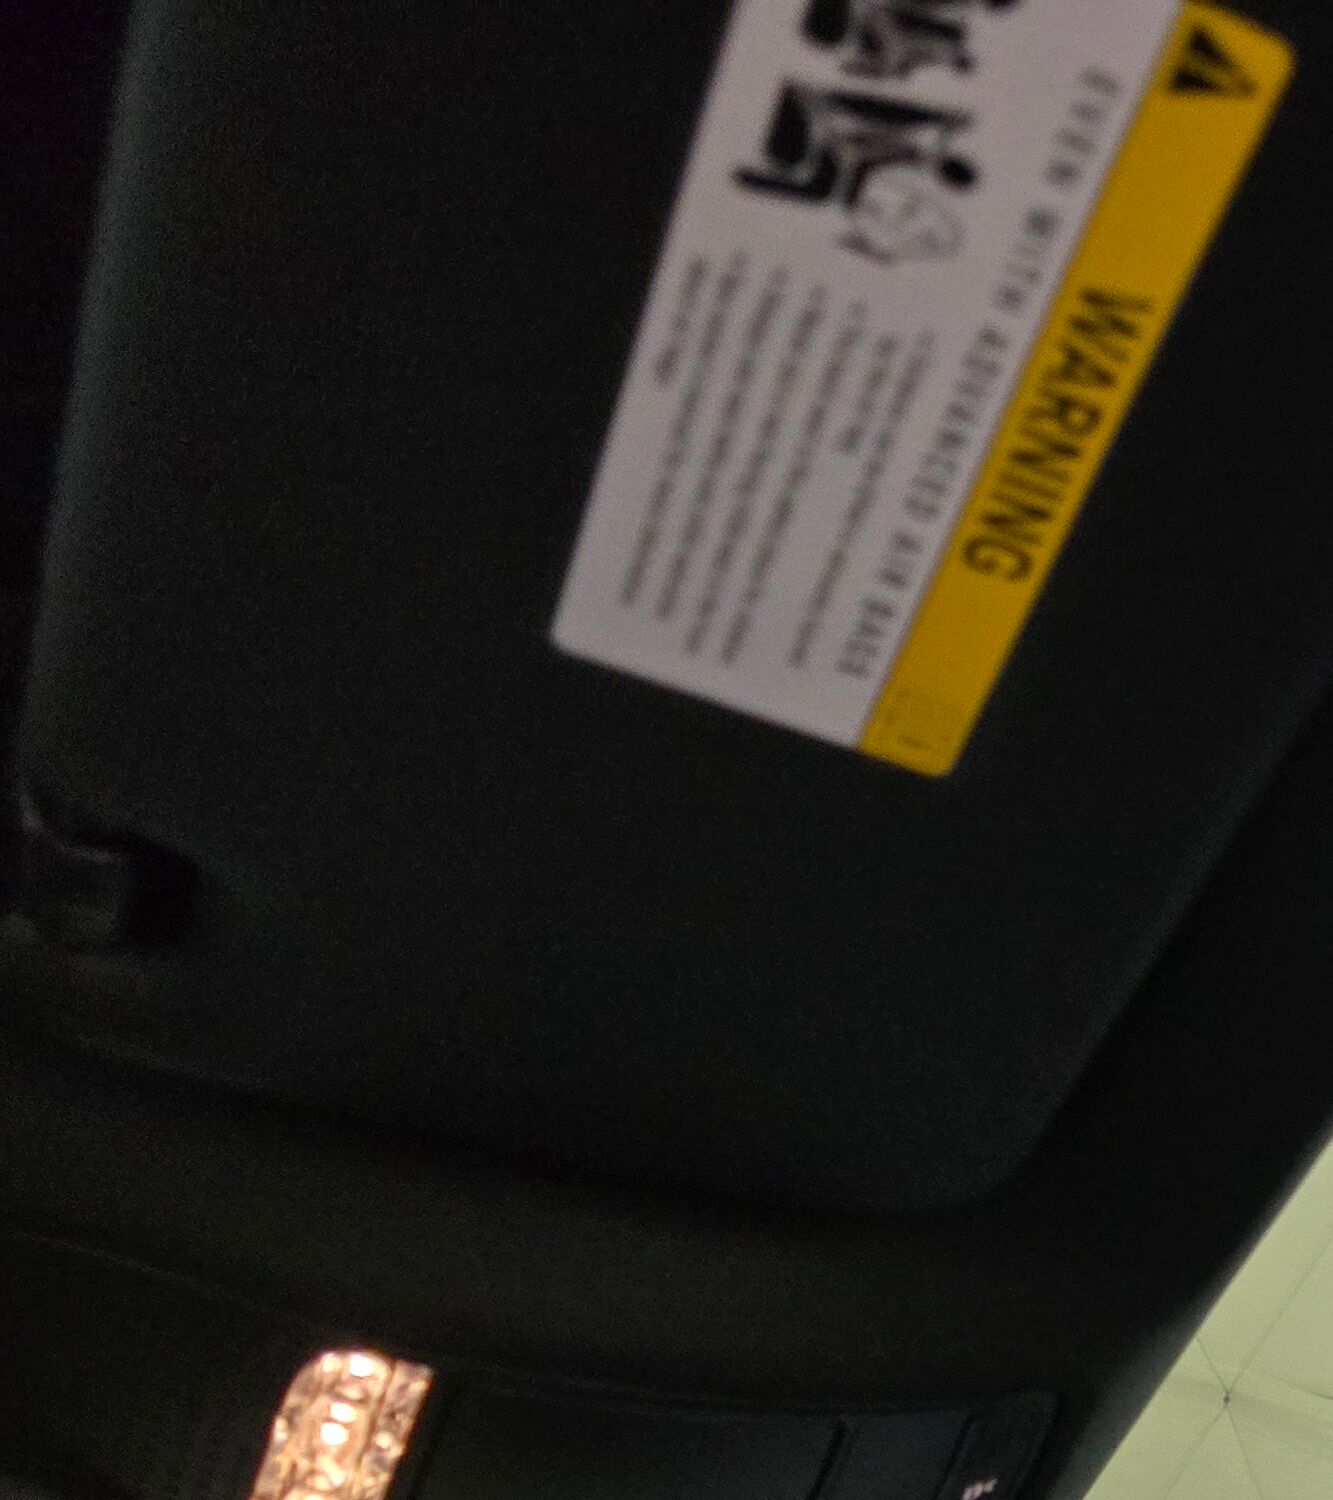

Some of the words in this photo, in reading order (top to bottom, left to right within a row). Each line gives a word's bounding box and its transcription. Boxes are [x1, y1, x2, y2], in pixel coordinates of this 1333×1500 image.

[1042, 66, 1120, 186] EVEN
[992, 210, 1062, 312] WITH
[904, 326, 1006, 518] ADVANCED
[958, 289, 1152, 587] WARNING
[878, 532, 921, 589] AIR
